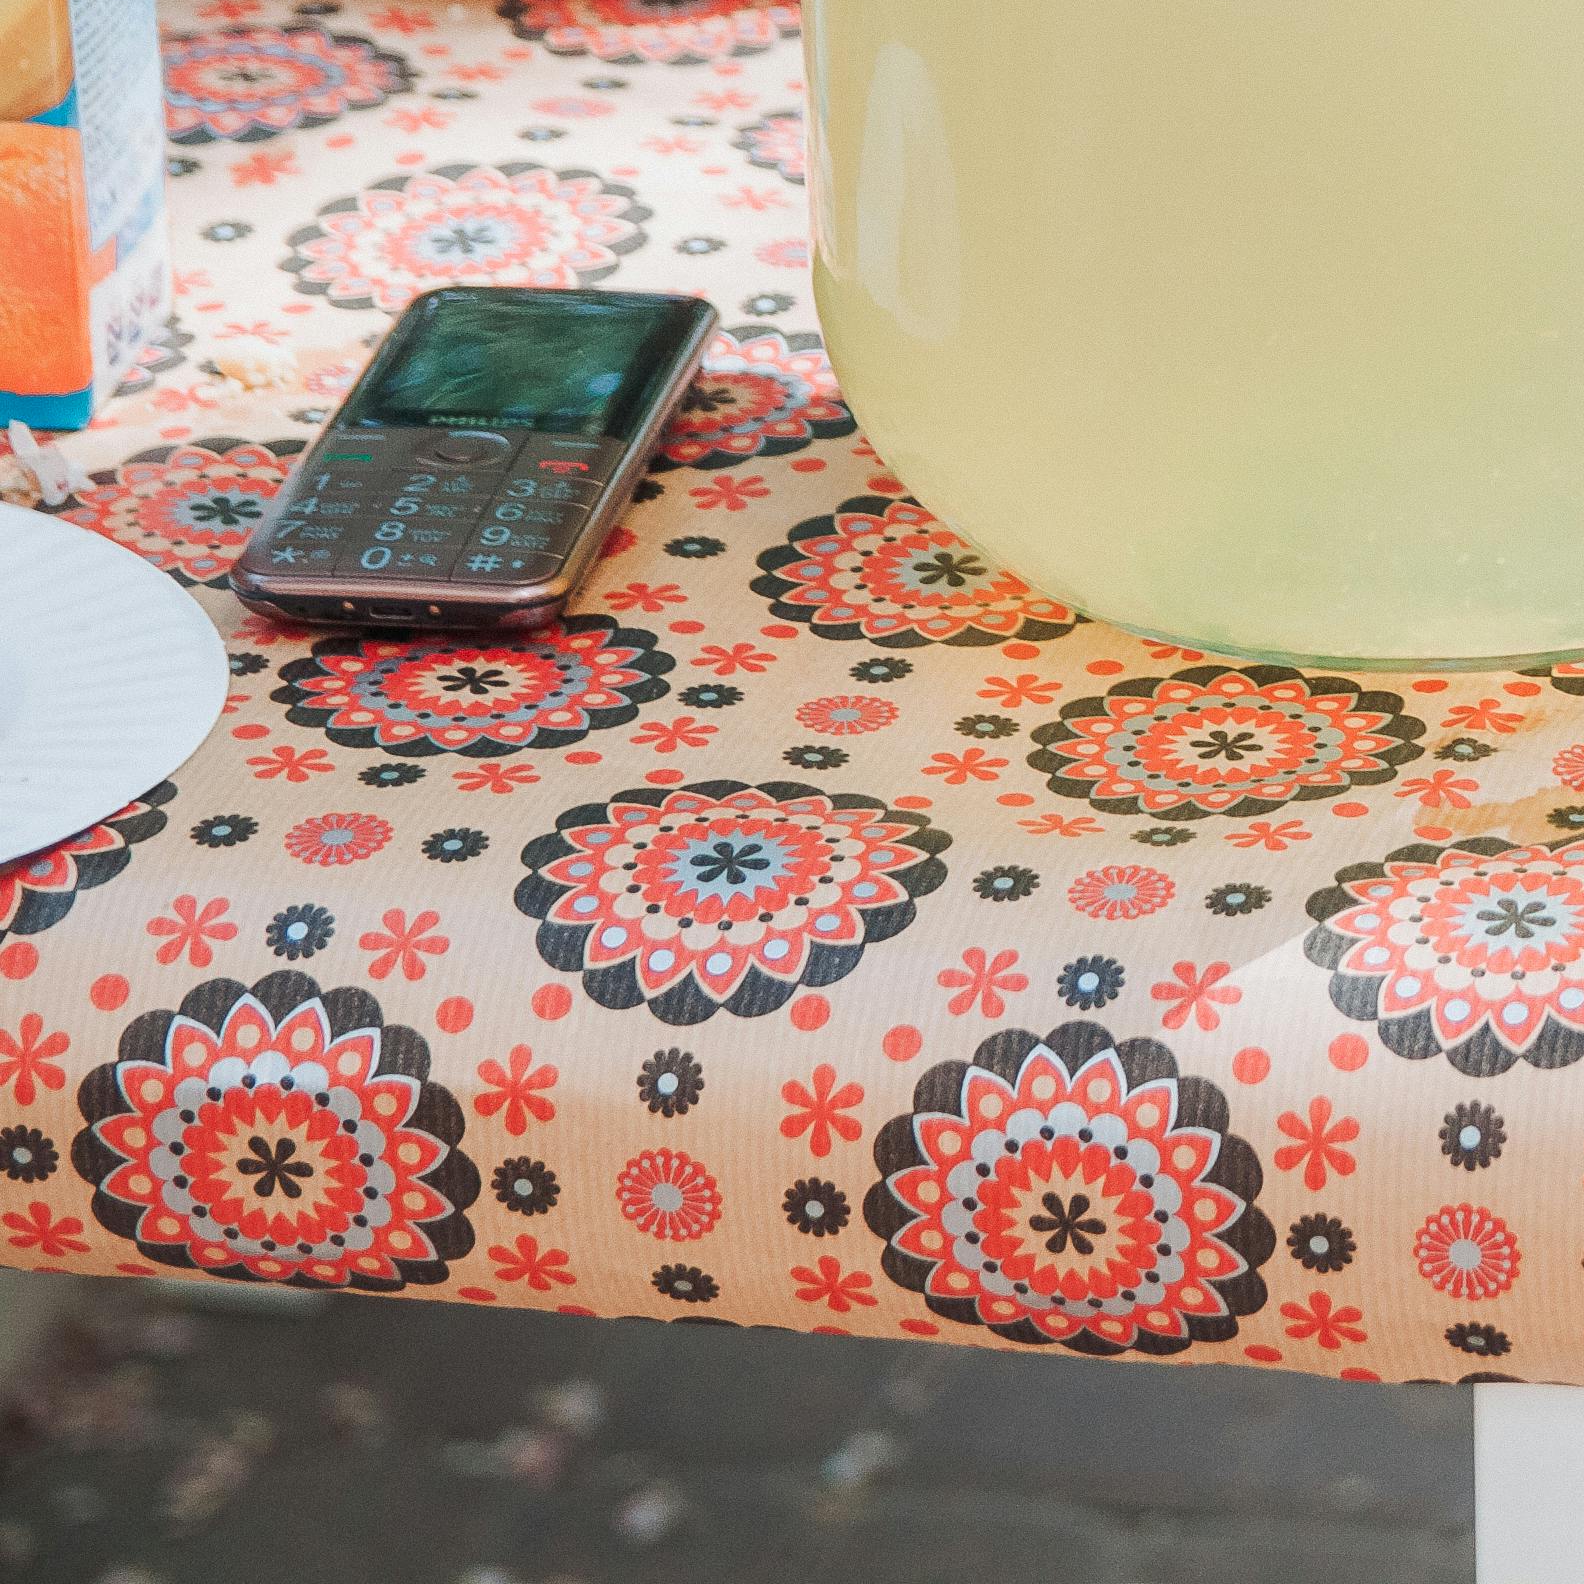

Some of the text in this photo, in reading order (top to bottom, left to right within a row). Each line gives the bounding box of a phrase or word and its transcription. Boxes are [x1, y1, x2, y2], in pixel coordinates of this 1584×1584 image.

[314, 473, 332, 492] 1
[403, 474, 437, 493] 2
[506, 478, 538, 498] 3
[287, 497, 319, 515] 4
[389, 497, 423, 516] 5
[495, 502, 527, 522] 6
[275, 519, 307, 539] 7
[374, 520, 406, 542] 8
[480, 525, 512, 547] 9
[360, 546, 393, 571] 0
